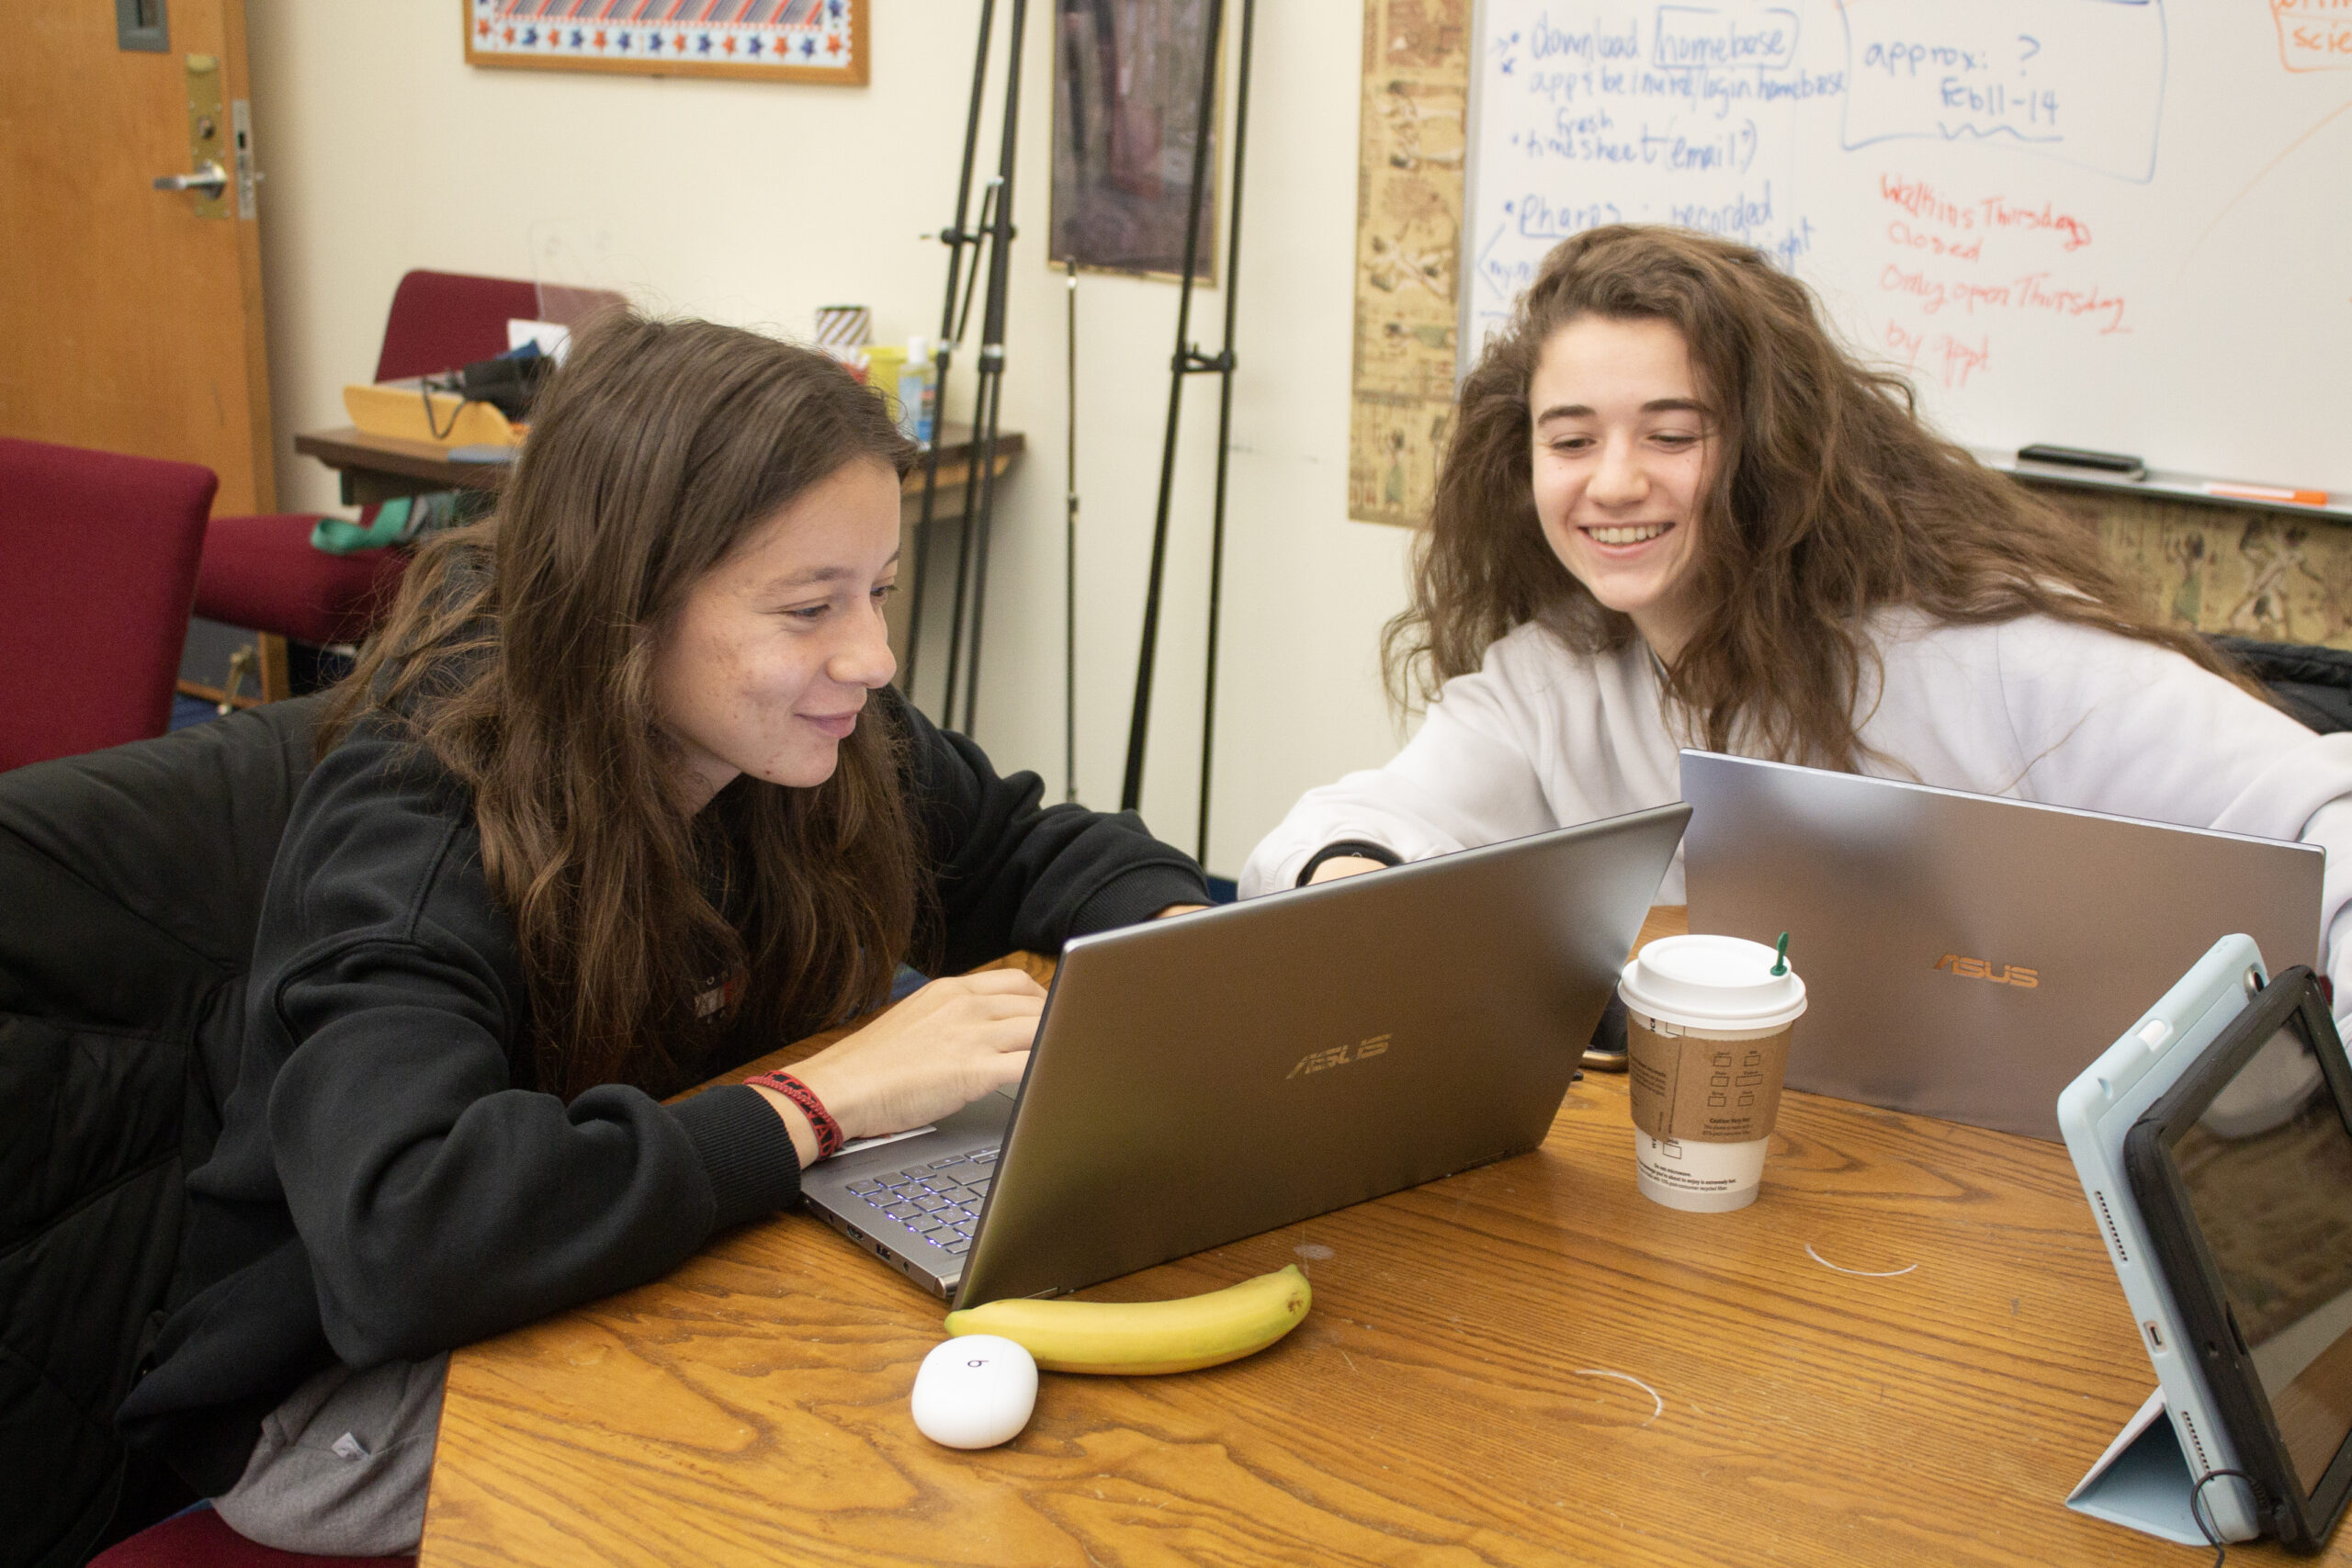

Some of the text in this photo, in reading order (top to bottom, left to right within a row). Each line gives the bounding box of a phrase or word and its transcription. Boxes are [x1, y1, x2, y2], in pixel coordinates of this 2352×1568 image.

[1530, 11, 1638, 62] download
[1951, 281, 2011, 314] open
[1886, 319, 1924, 375] by
[1933, 954, 2040, 988] ASUS
[1286, 1032, 1393, 1079] ASUS
